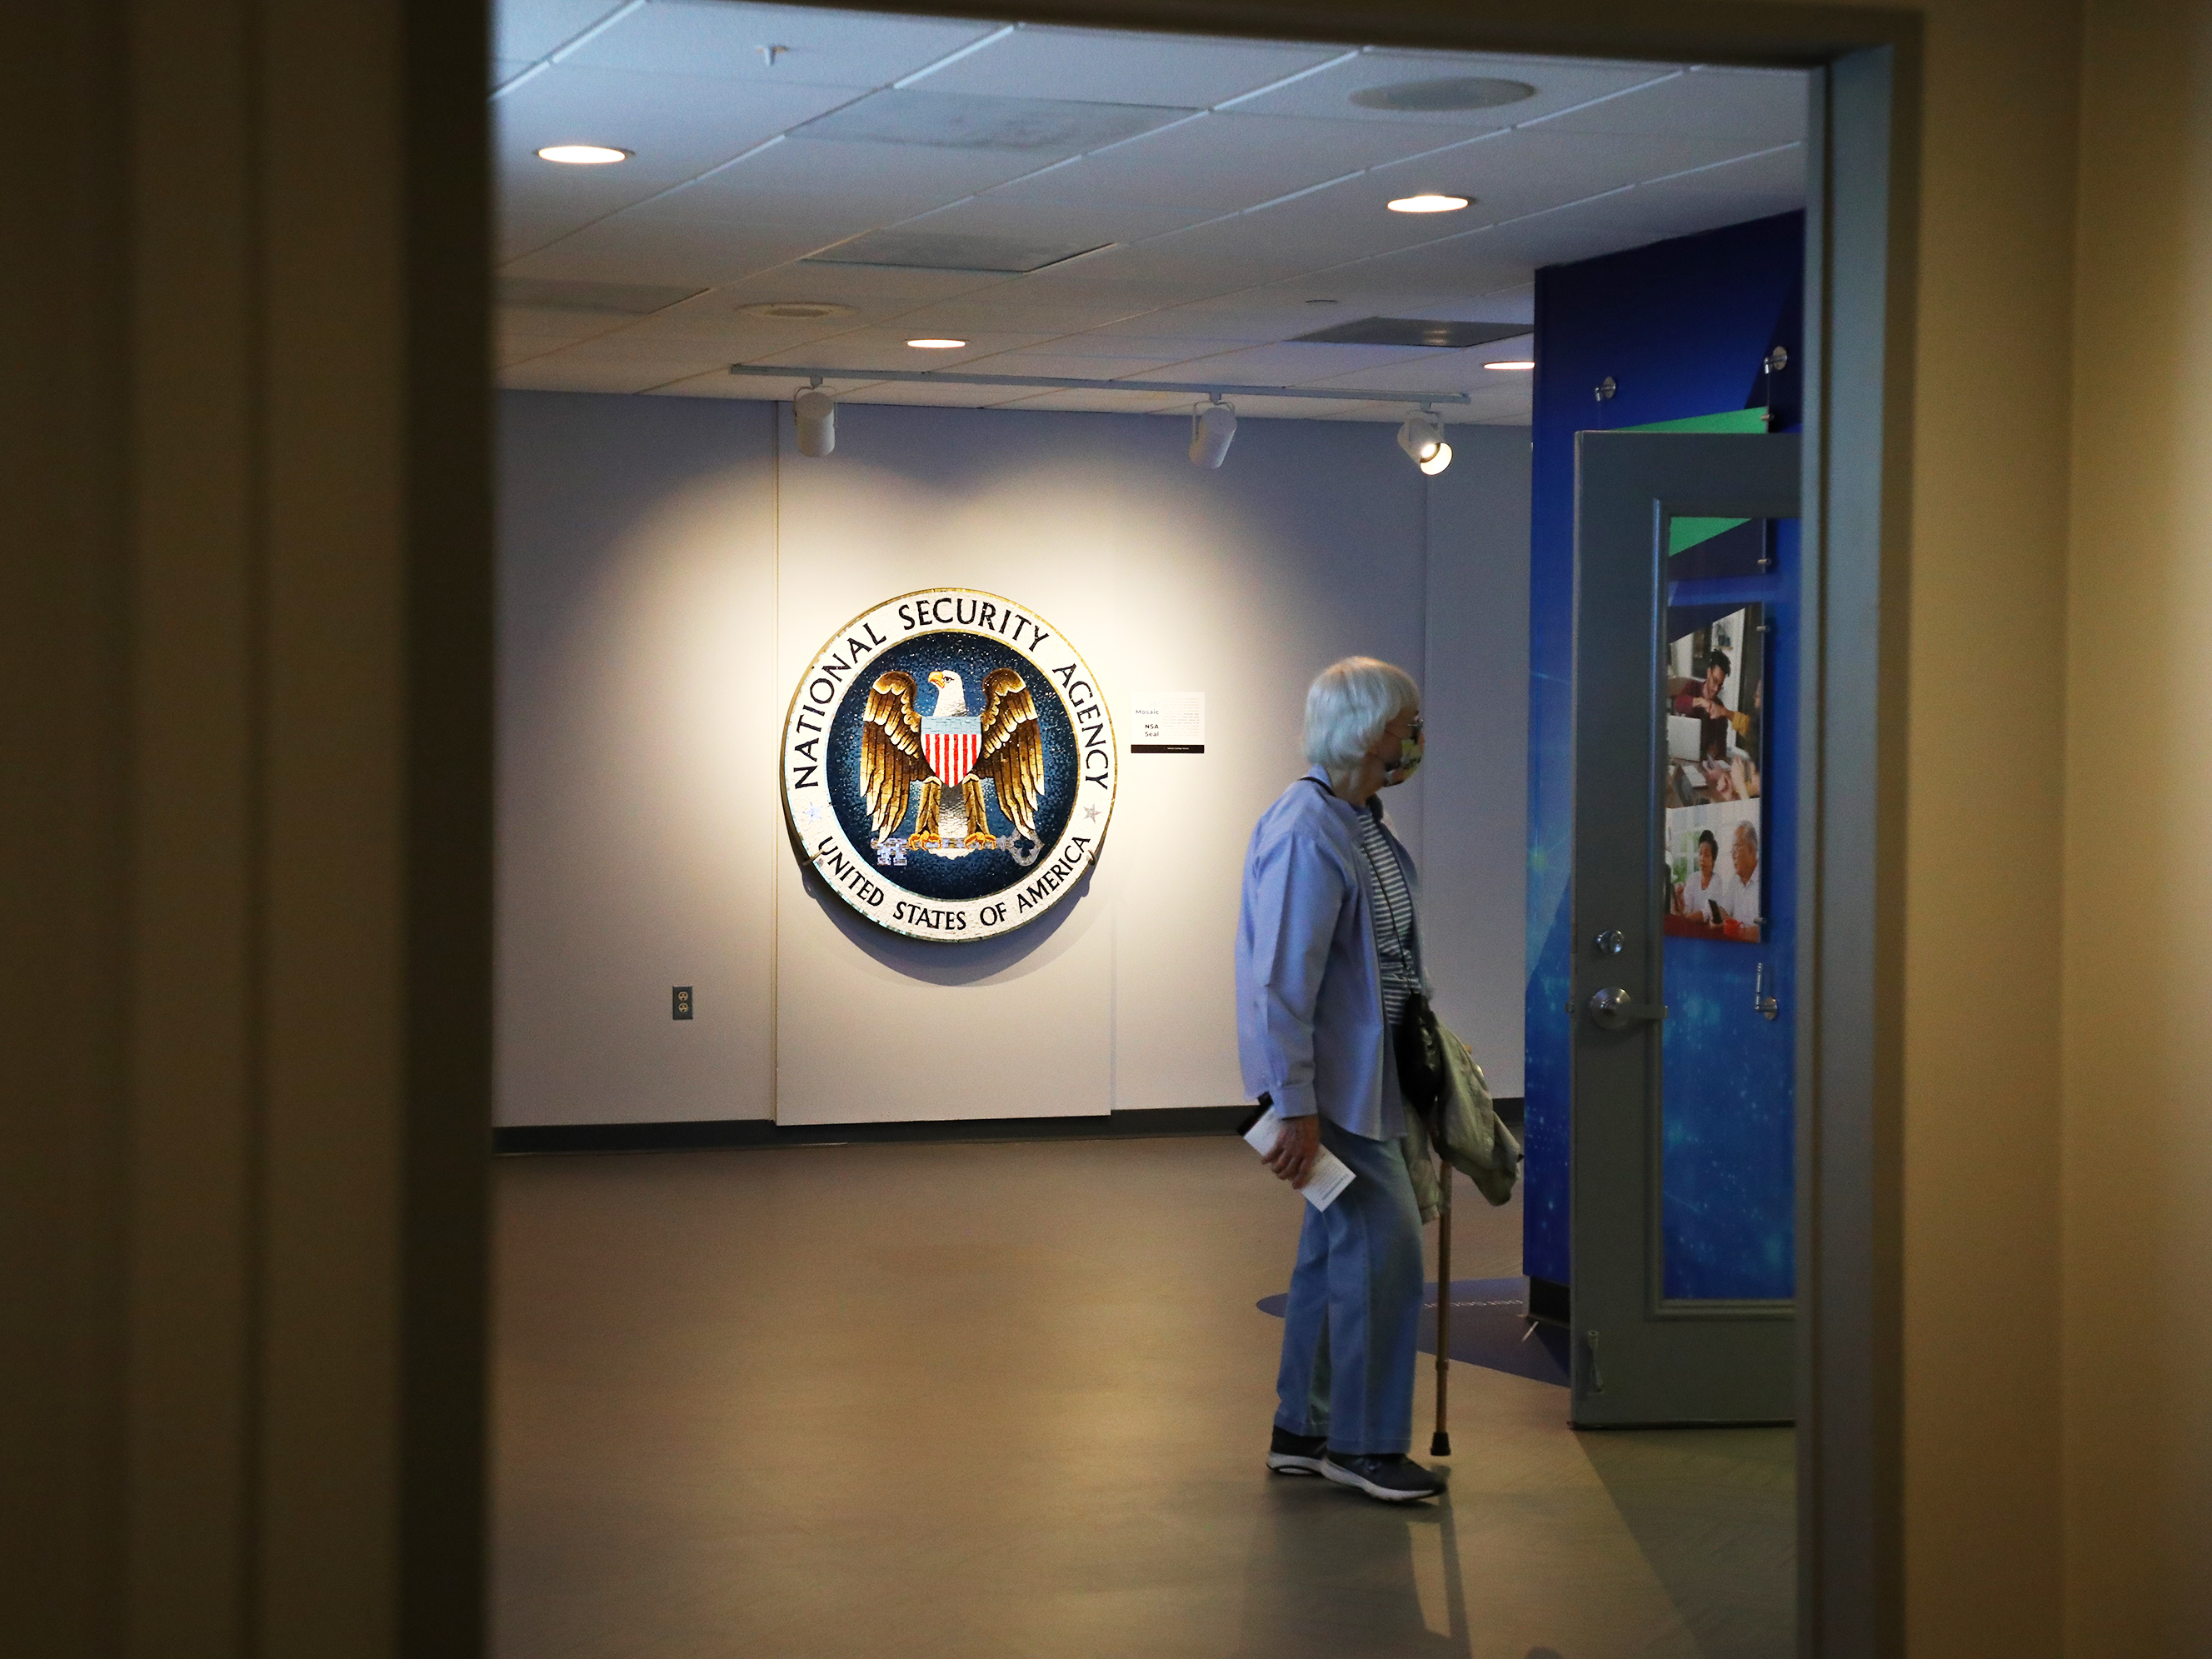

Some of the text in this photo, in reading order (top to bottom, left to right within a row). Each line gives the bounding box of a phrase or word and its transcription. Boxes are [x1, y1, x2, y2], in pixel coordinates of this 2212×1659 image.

[793, 597, 1109, 791] NATIONAL SECURITY AGENCY
[818, 835, 1091, 932] UNITED STATES OF AMERICA
